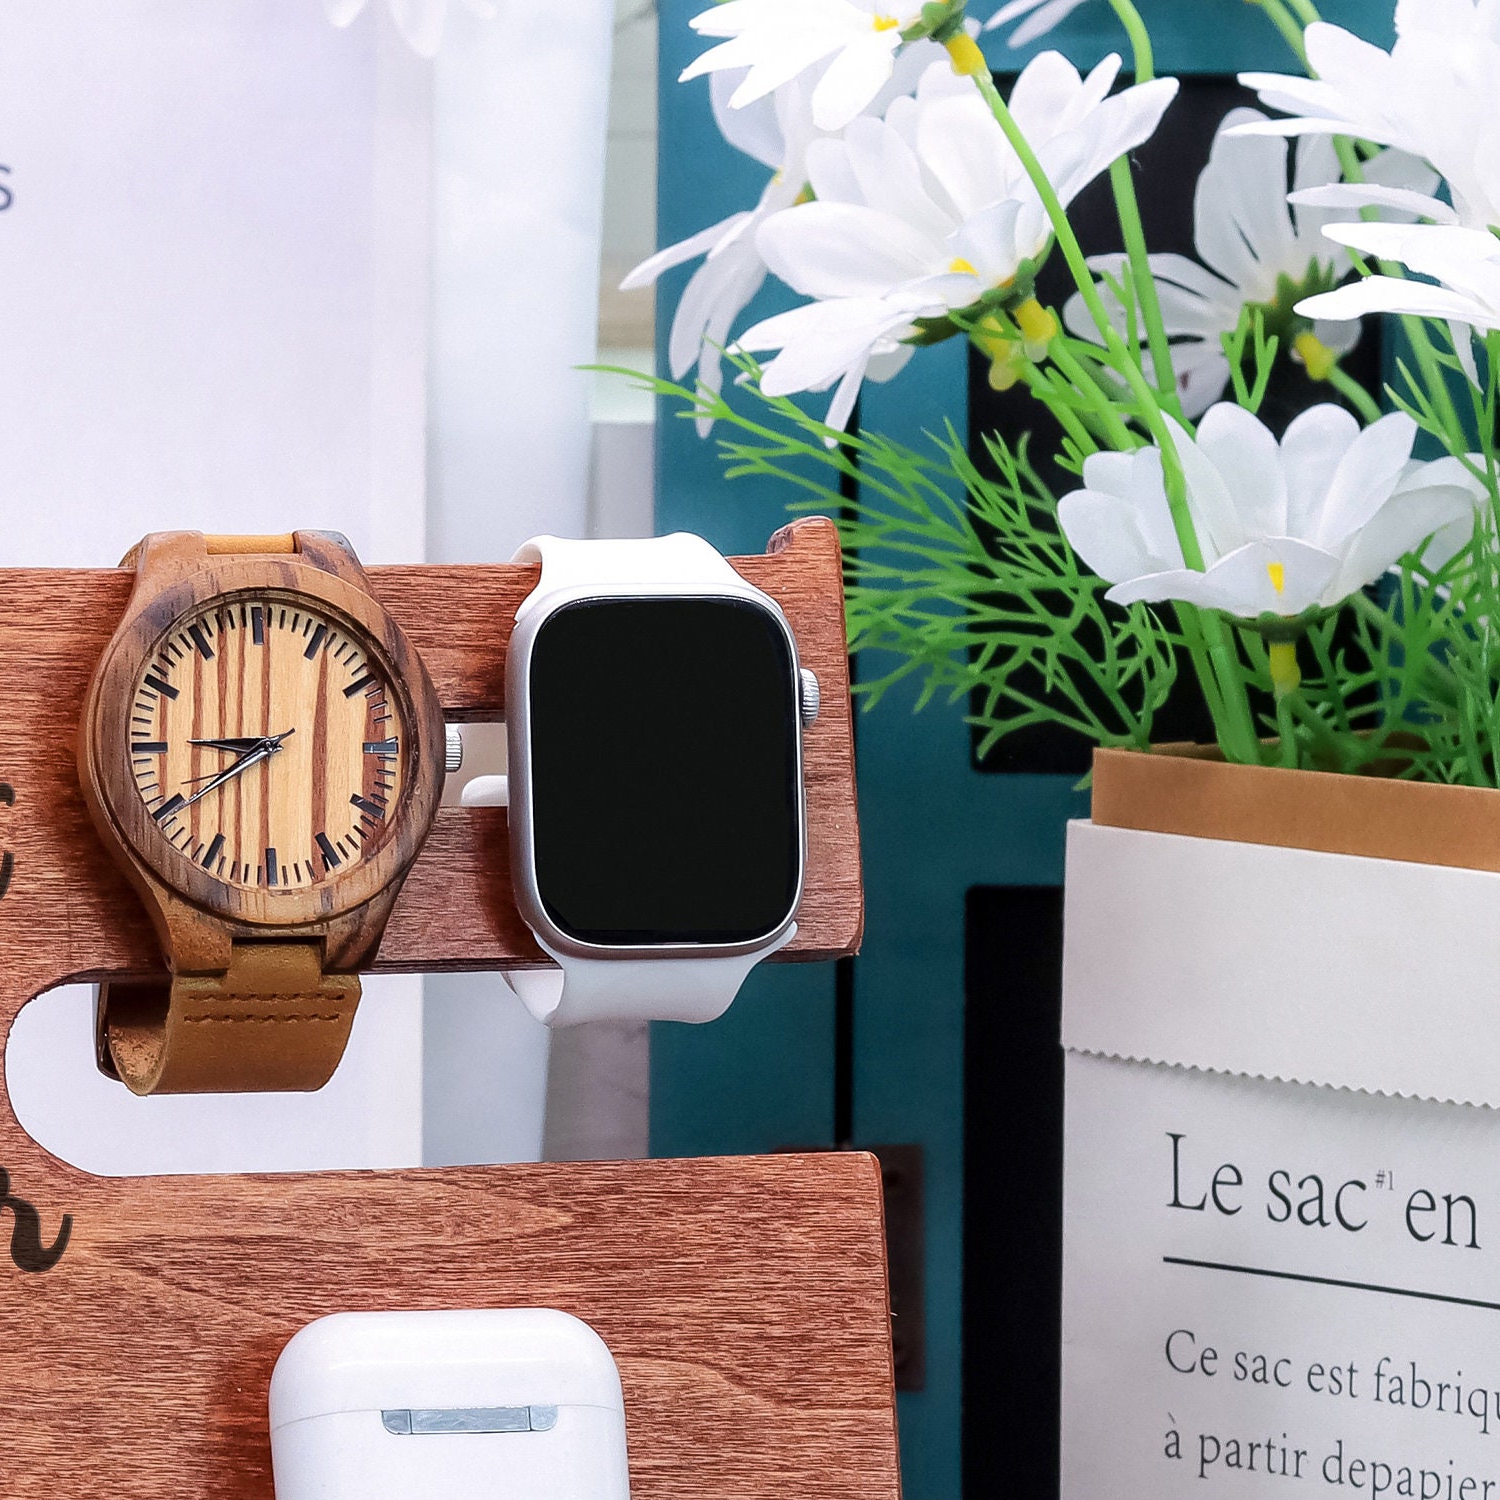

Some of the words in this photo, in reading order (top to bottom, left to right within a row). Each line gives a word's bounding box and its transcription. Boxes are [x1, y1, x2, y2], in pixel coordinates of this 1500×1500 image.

[1166, 1132, 1243, 1216] Le
[1267, 1170, 1367, 1232] sac
[1406, 1189, 1481, 1249] en
[1165, 1330, 1217, 1376] Ce
[1234, 1352, 1291, 1387] sac
[1307, 1362, 1358, 1398] est
[1164, 1413, 1182, 1459] à
[1198, 1433, 1307, 1479] partir
